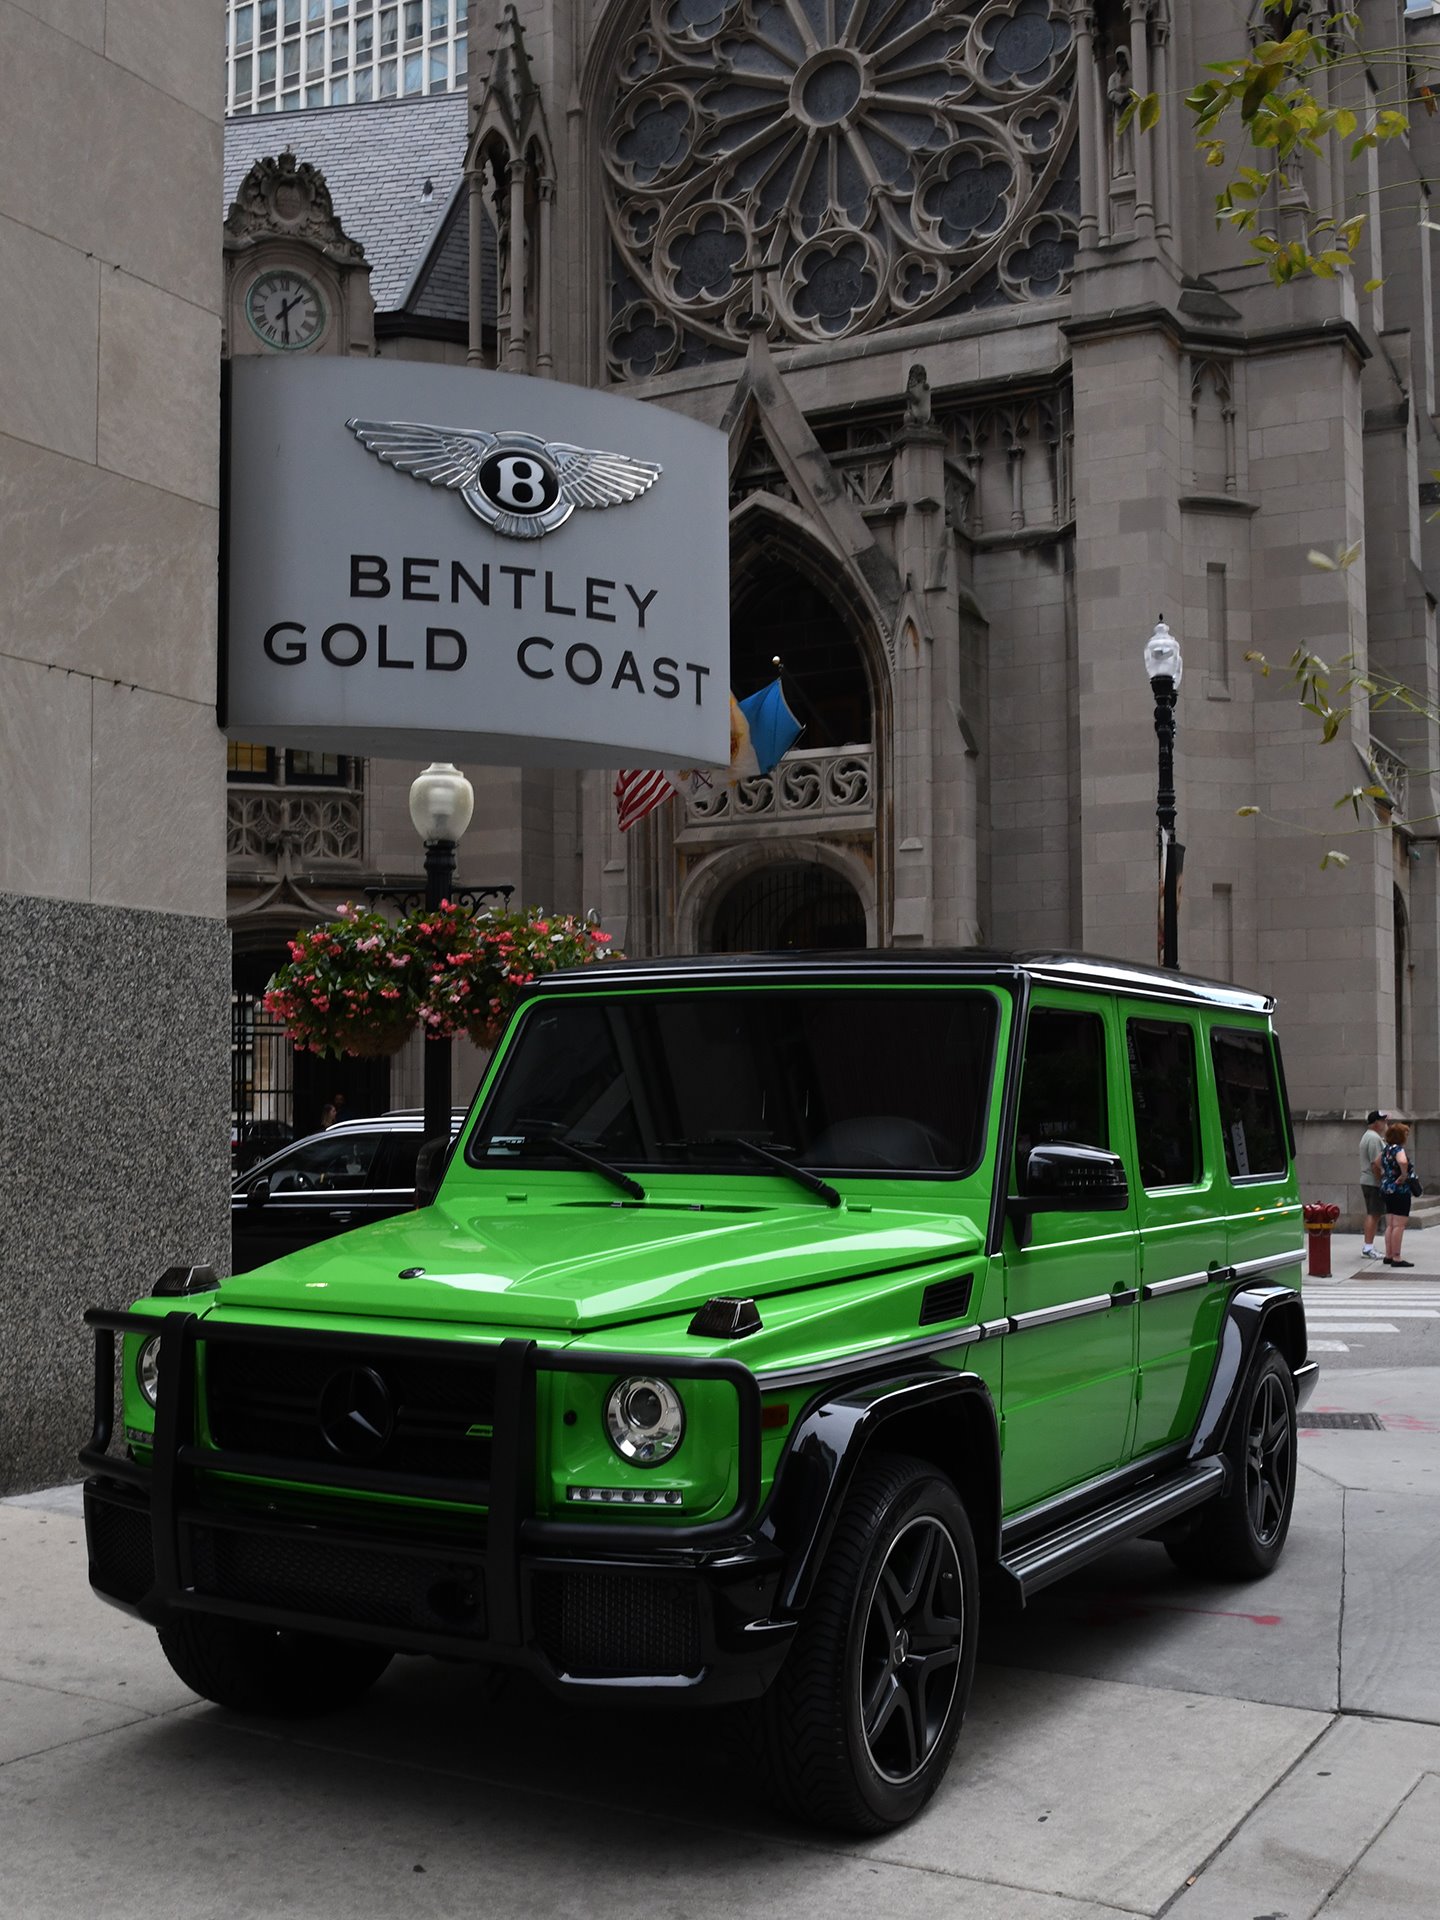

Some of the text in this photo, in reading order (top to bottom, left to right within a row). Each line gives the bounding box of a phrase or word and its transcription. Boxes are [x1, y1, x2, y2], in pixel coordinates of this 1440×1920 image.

[496, 456, 546, 508] B
[349, 554, 658, 629] BENTLEY
[262, 620, 711, 706] GOLD COAST
